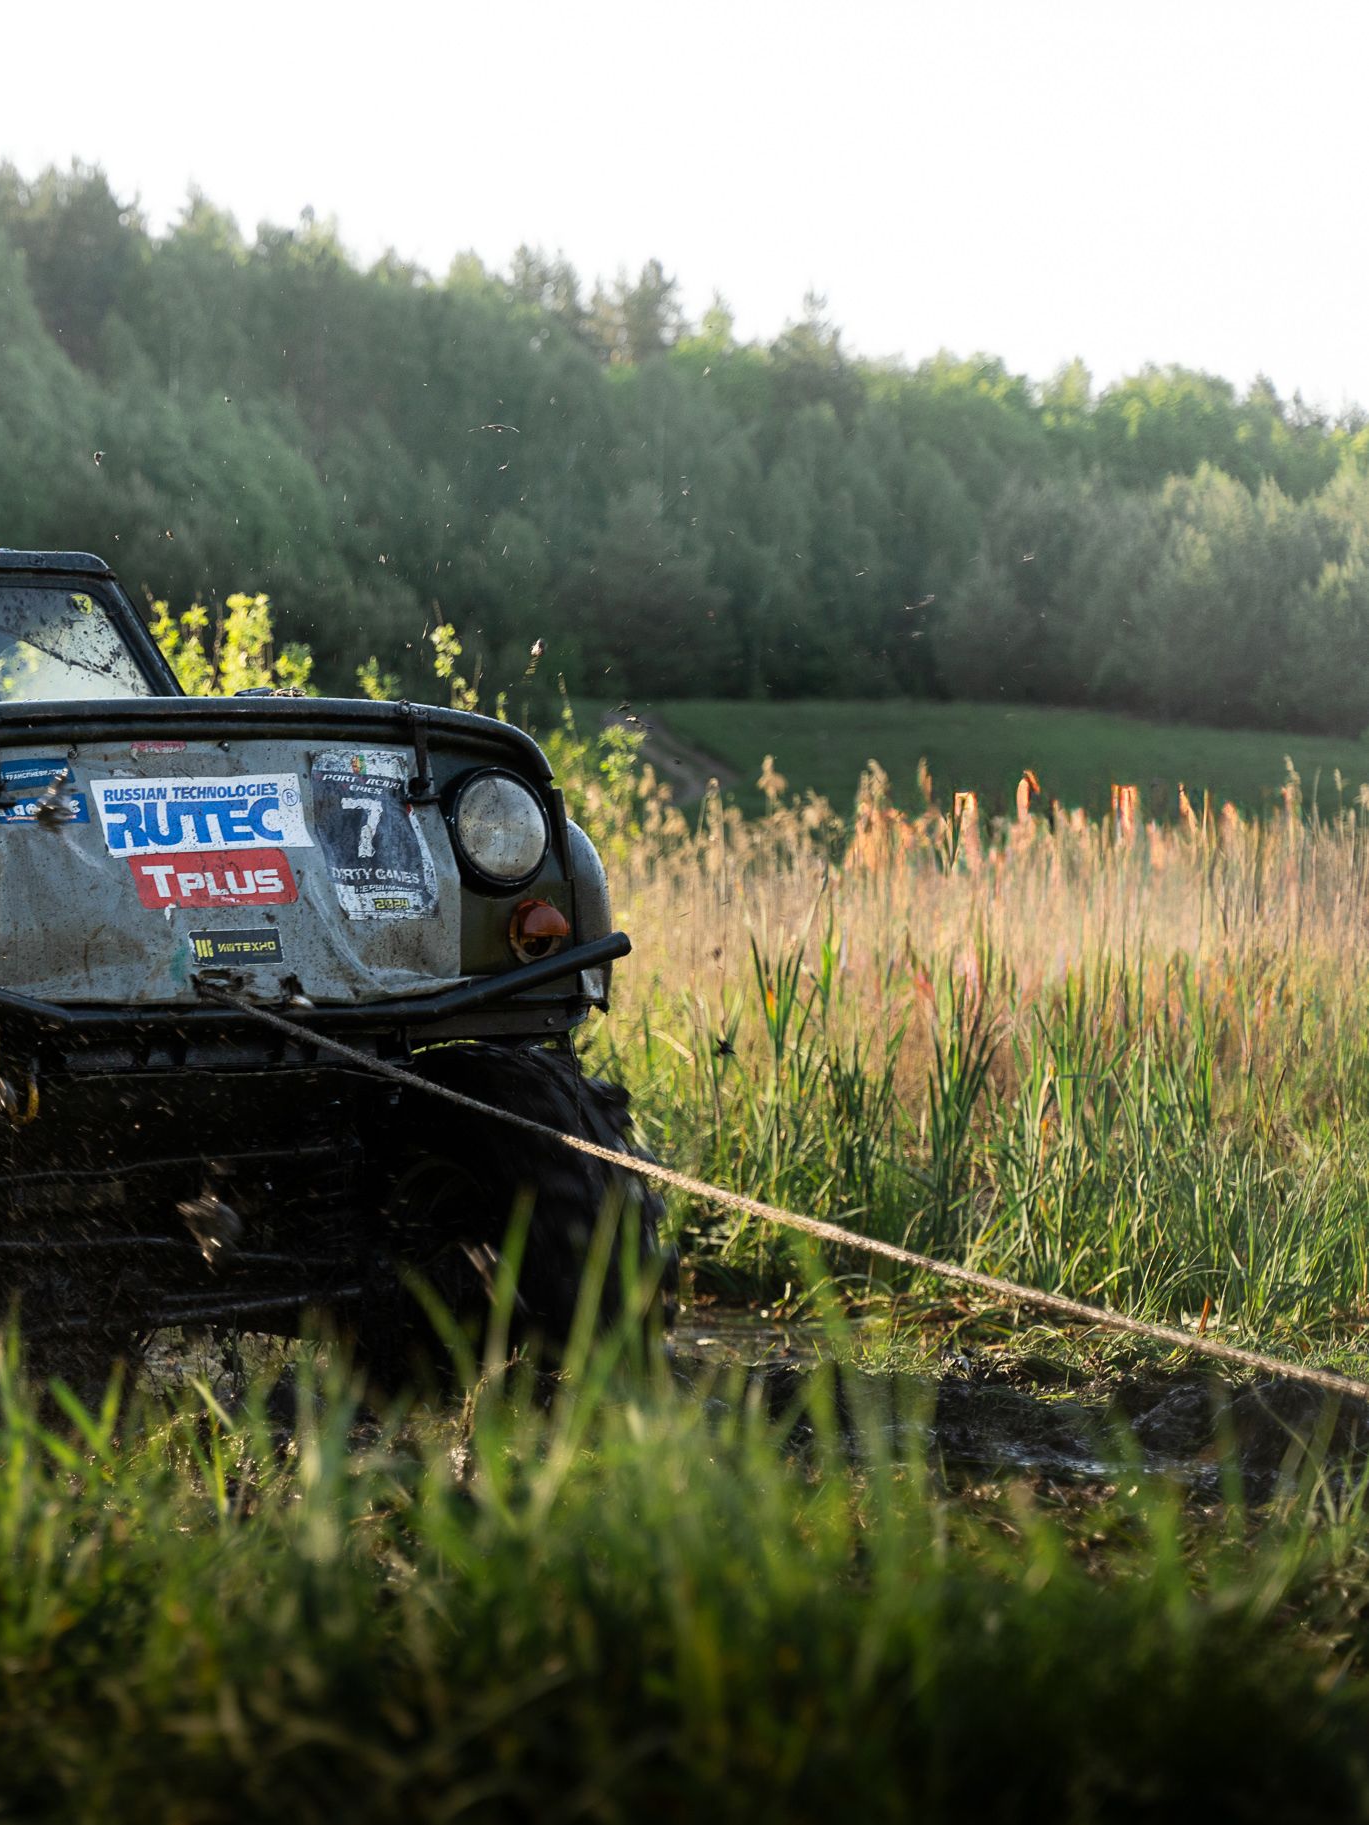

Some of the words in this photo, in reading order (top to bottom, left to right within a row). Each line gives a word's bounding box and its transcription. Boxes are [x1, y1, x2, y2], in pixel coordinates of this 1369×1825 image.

[104, 787, 167, 802] RUSSIAN
[172, 783, 278, 800] TECHNOLOGIES
[104, 797, 284, 849] RUTEC
[340, 797, 384, 859] 7
